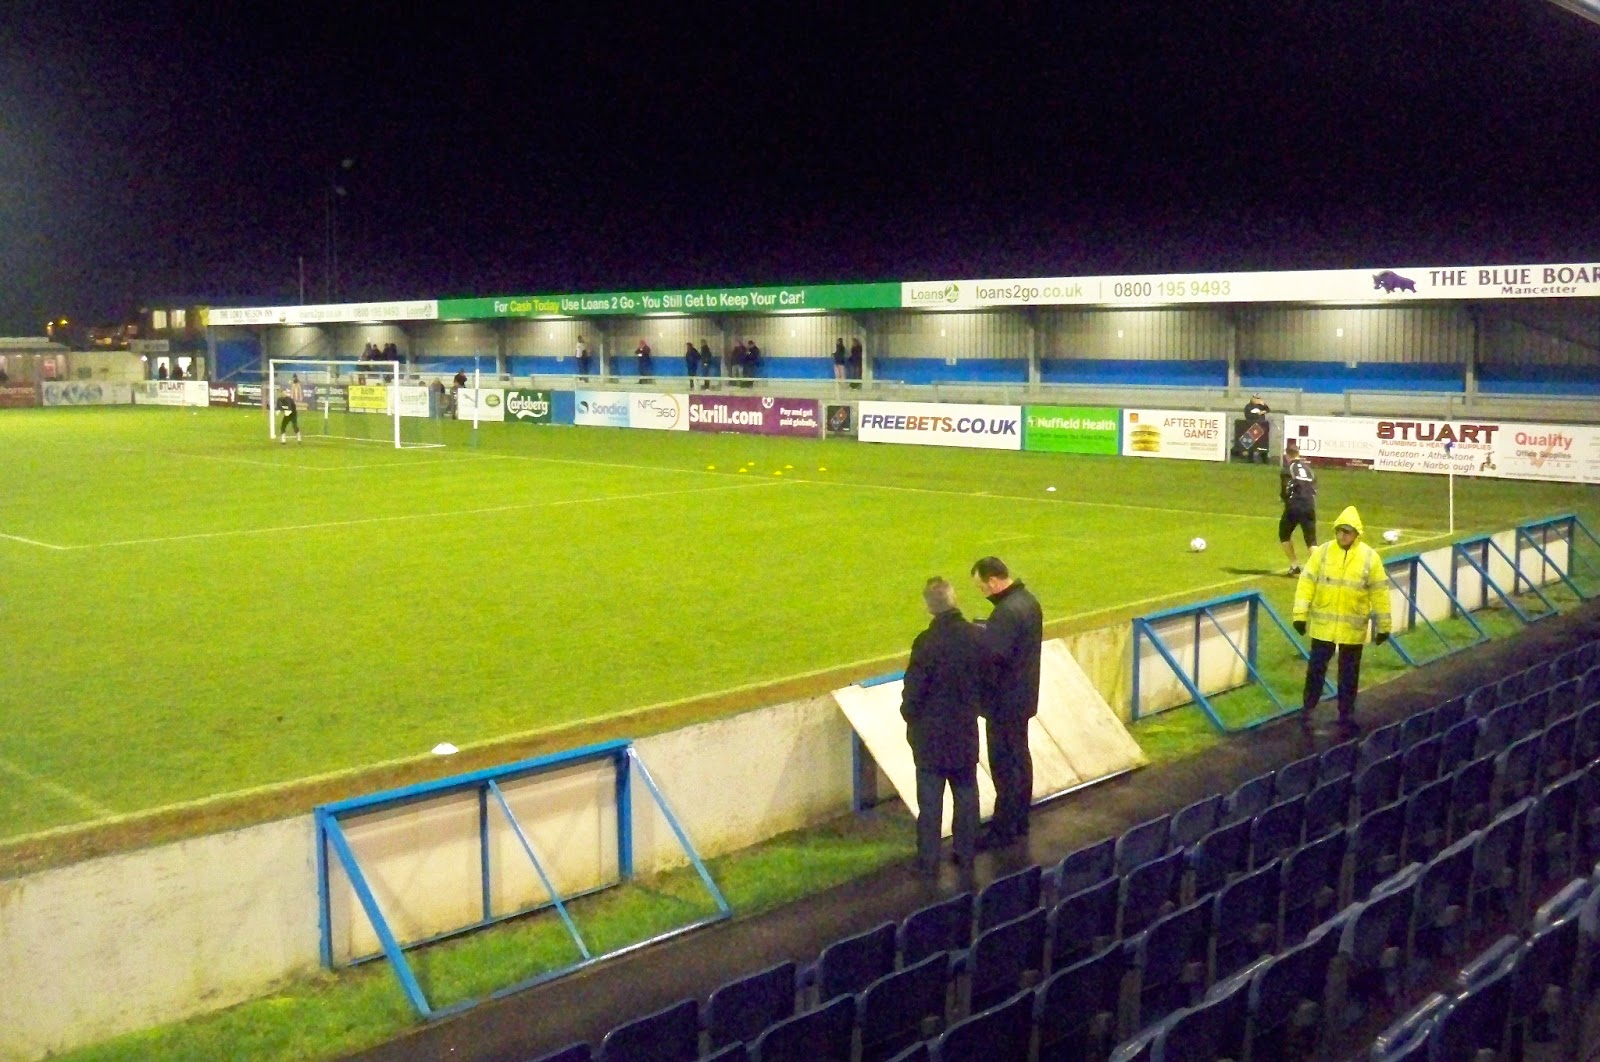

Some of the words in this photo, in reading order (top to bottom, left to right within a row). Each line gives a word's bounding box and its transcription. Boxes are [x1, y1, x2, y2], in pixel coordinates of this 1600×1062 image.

[1429, 270, 1467, 287] THE
[1478, 268, 1532, 286] BLUE
[1543, 266, 1600, 284] BOAR
[911, 288, 944, 300] Loans
[976, 283, 1083, 302] loans2go.co.uk
[1114, 282, 1152, 297] 0800
[1157, 281, 1186, 296] 195
[1190, 280, 1231, 296] 9493
[1501, 286, 1577, 295] Mancetter
[494, 300, 508, 313] For
[510, 300, 531, 312] Cash
[533, 299, 559, 314] Today
[561, 298, 579, 311] Use
[581, 297, 609, 310] Loans
[612, 297, 618, 309] 2
[619, 296, 634, 309] Go
[642, 295, 661, 309] You
[662, 294, 682, 308] Still
[685, 293, 705, 307] Get
[706, 295, 717, 307] to
[720, 293, 748, 309] Keep
[750, 292, 776, 306] Your
[779, 290, 805, 304] Car!
[506, 391, 549, 418] Carlsberg
[592, 401, 628, 416] Sondico
[637, 399, 658, 410] NFC
[656, 408, 676, 418] 360
[689, 404, 763, 426] Skrill.com
[780, 407, 791, 417] Pay
[791, 408, 802, 416] and
[802, 408, 813, 418] get
[780, 417, 792, 427] paid
[861, 414, 1017, 436] FREEBETS.CO.UK
[1037, 416, 1080, 430] Nuffield
[1082, 418, 1116, 431] Health
[1163, 417, 1196, 428] AFTER
[1199, 418, 1219, 429] THE
[1183, 429, 1219, 439] GAME?
[1376, 421, 1499, 444] STUART
[1298, 439, 1322, 452] LDJ
[1323, 440, 1374, 450] SOLICITORS
[1515, 431, 1573, 451] Quality
[1378, 448, 1419, 459] Nuneaton
[1427, 450, 1475, 461] Athetone
[1379, 458, 1415, 469] Hinckley
[1423, 461, 1475, 473] Narboough
